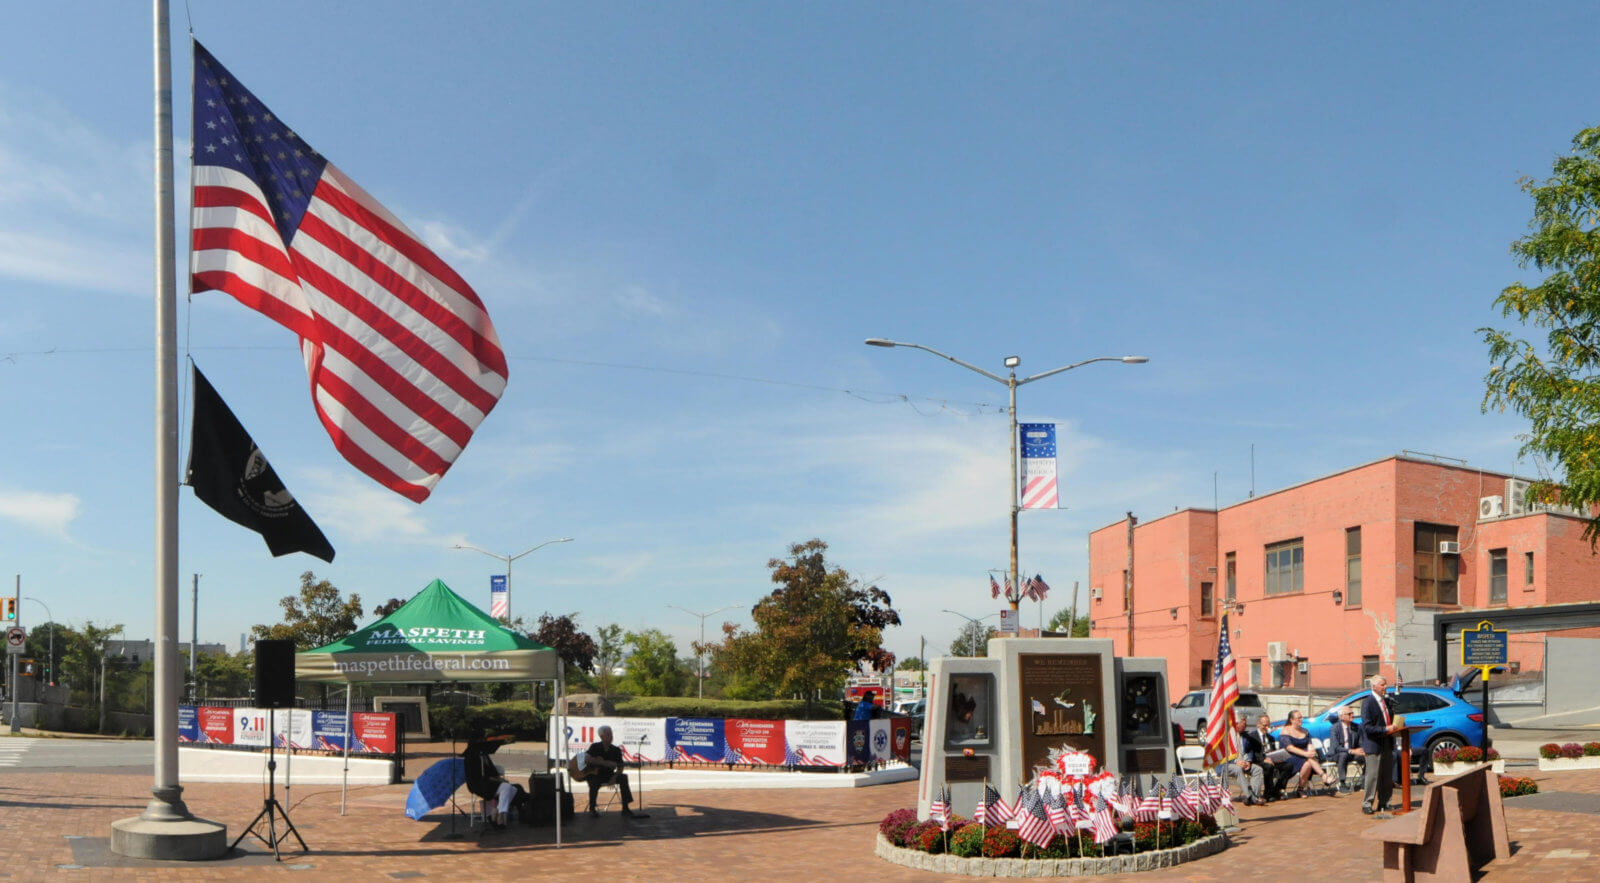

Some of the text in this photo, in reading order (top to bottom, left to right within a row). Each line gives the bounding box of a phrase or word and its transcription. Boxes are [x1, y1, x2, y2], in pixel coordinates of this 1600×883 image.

[369, 627, 486, 639] MASPETH
[366, 637, 485, 646] FEDERAL SAVINGS
[332, 654, 511, 676] maspethfederal.com
[240, 716, 265, 731] 9.11
